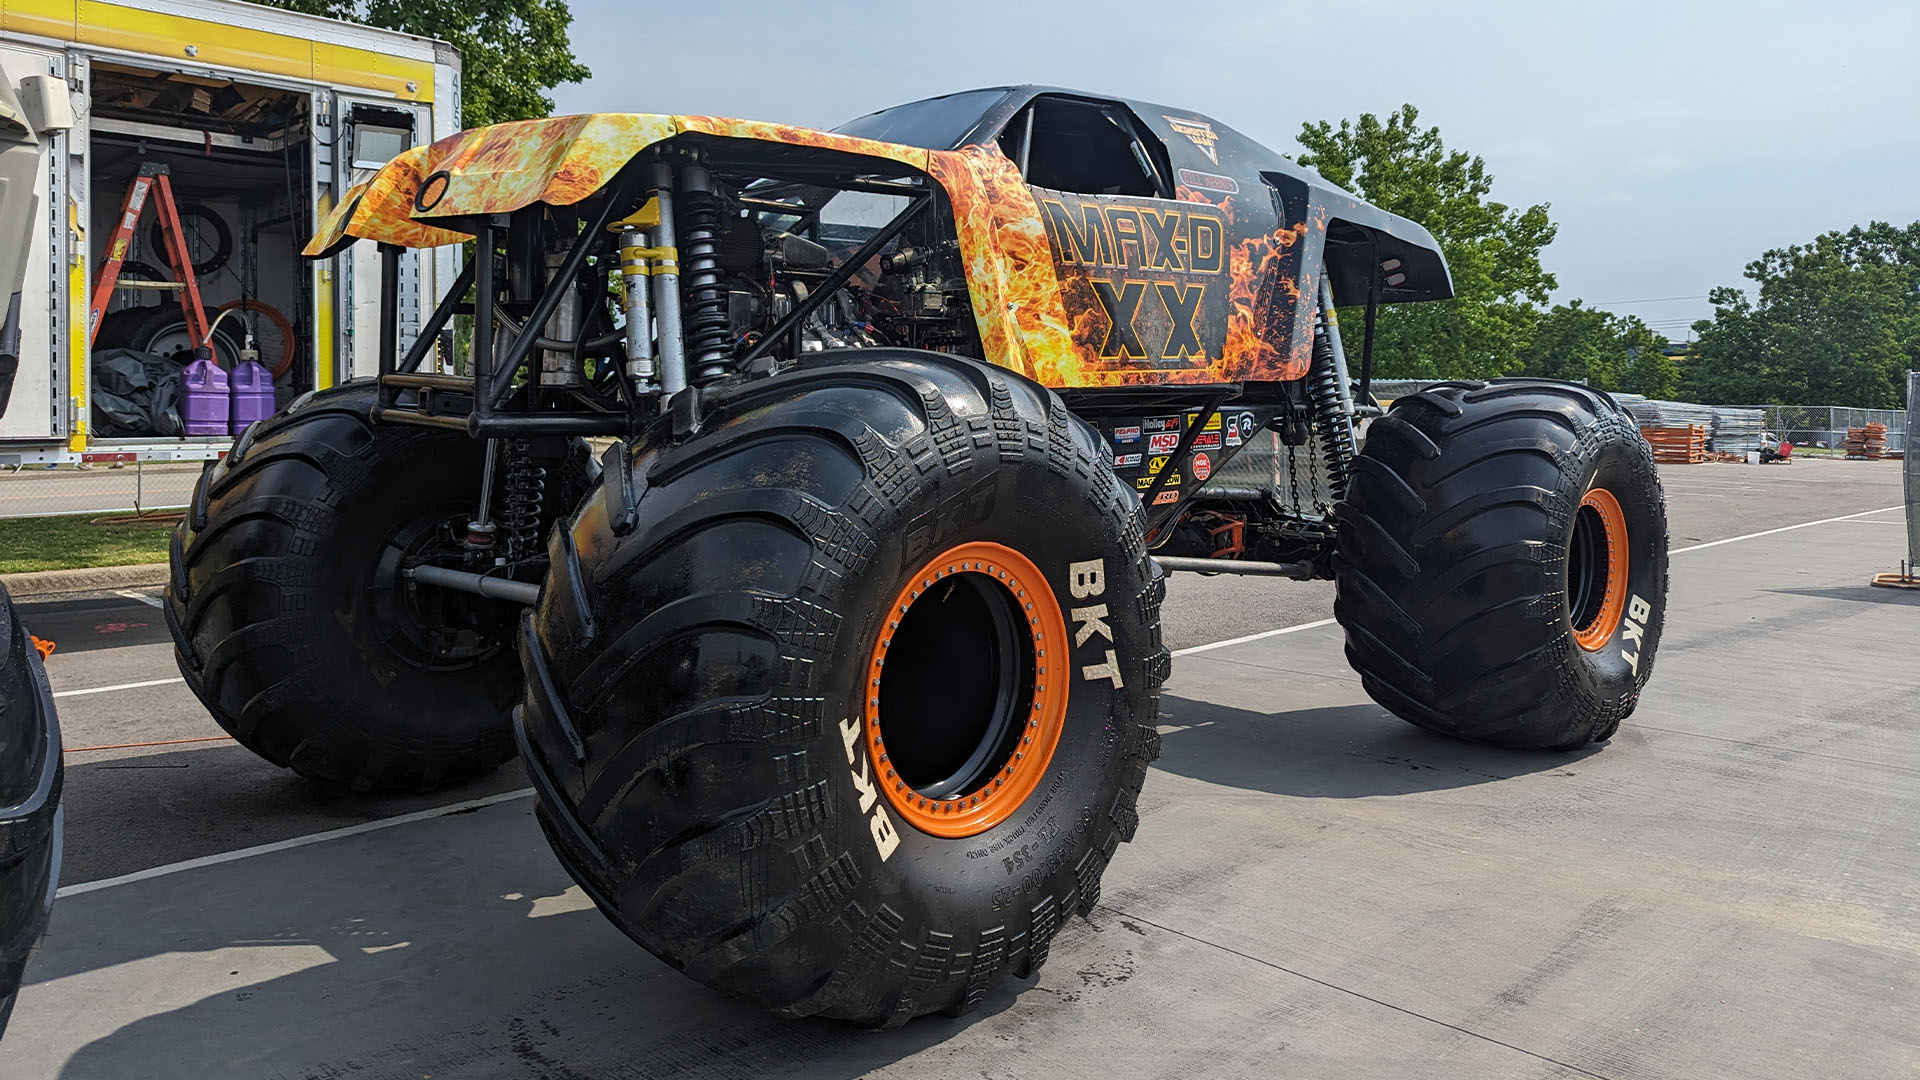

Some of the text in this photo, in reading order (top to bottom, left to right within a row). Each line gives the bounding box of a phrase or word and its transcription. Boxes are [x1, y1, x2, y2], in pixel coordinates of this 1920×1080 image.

[1040, 199, 1225, 275] MAX-D
[1089, 279, 1207, 361] XX
[1144, 418, 1166, 431] Holley
[1150, 434, 1179, 449] MSD
[1069, 558, 1124, 689] BKT
[1621, 593, 1652, 678] BKT
[839, 715, 901, 863] BKT
